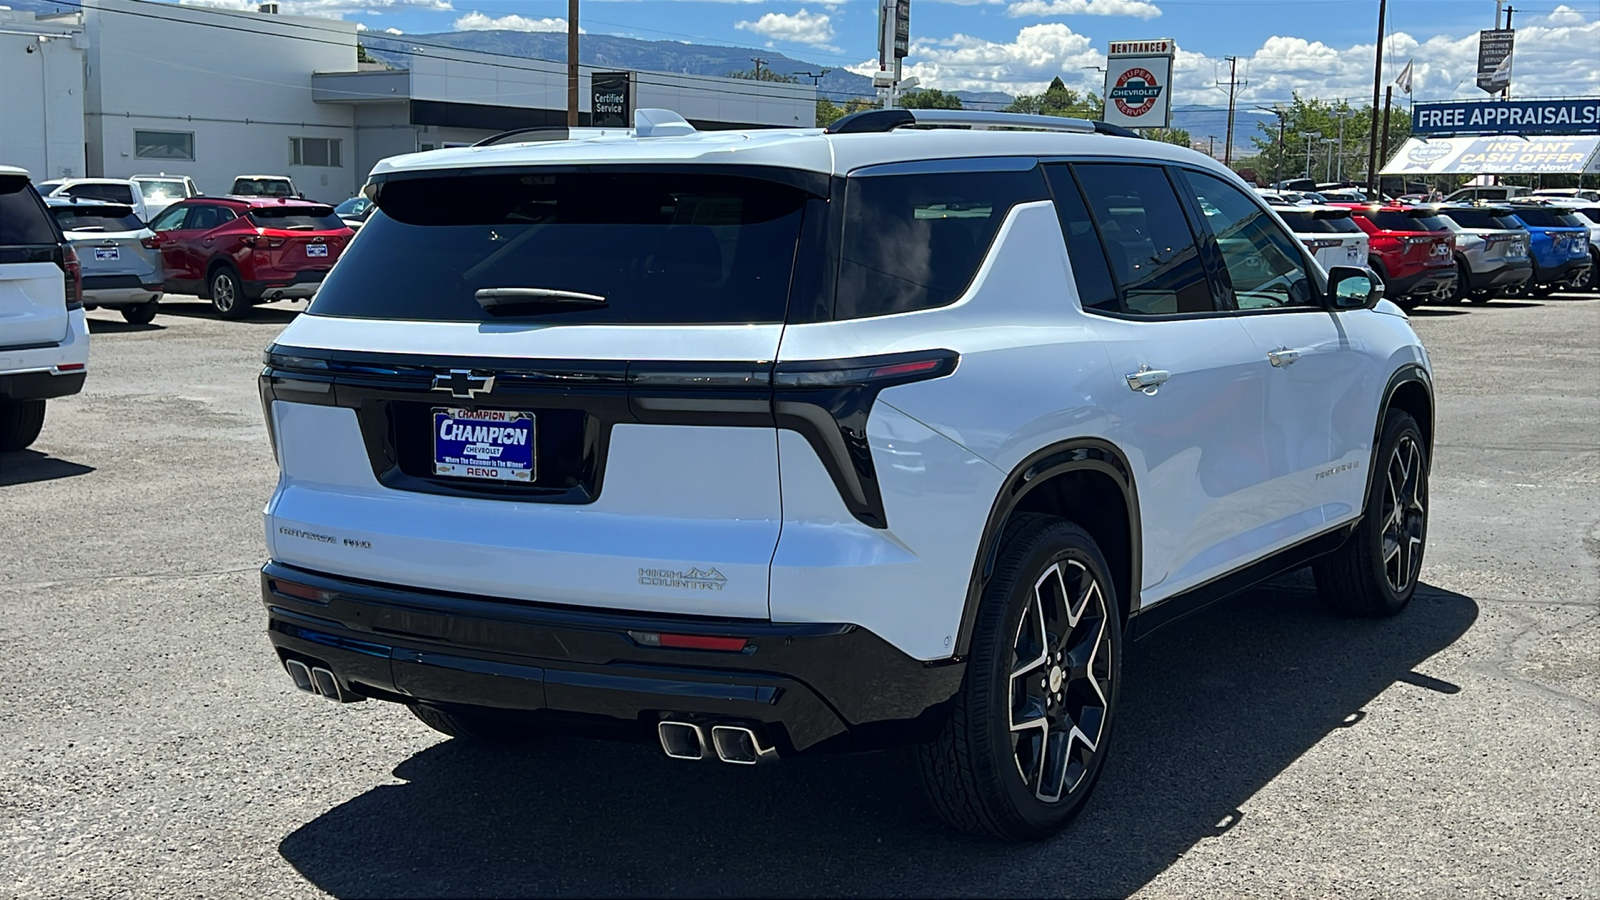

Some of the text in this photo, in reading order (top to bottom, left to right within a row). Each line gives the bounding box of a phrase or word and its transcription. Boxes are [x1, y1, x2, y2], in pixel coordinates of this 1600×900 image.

[1117, 43, 1160, 53] ENTRANCE
[1121, 69, 1152, 82] SUPER
[595, 93, 624, 103] Certified
[596, 103, 622, 112] Service
[1117, 100, 1153, 116] SERVICE
[1418, 106, 1600, 127] FREE APPRAISALS!
[1485, 142, 1574, 152] INSTANT
[1460, 153, 1585, 163] CASH OFFER
[1456, 164, 1480, 172] For
[1481, 163, 1511, 171] Your
[1537, 163, 1574, 171] Now!
[457, 410, 505, 420] CHAMPION
[440, 419, 528, 445] CHAMPION
[466, 446, 500, 455] CHEVROLET
[467, 467, 498, 477] RENO
[638, 567, 683, 579] HIGH
[638, 577, 726, 590] COUNTRY
